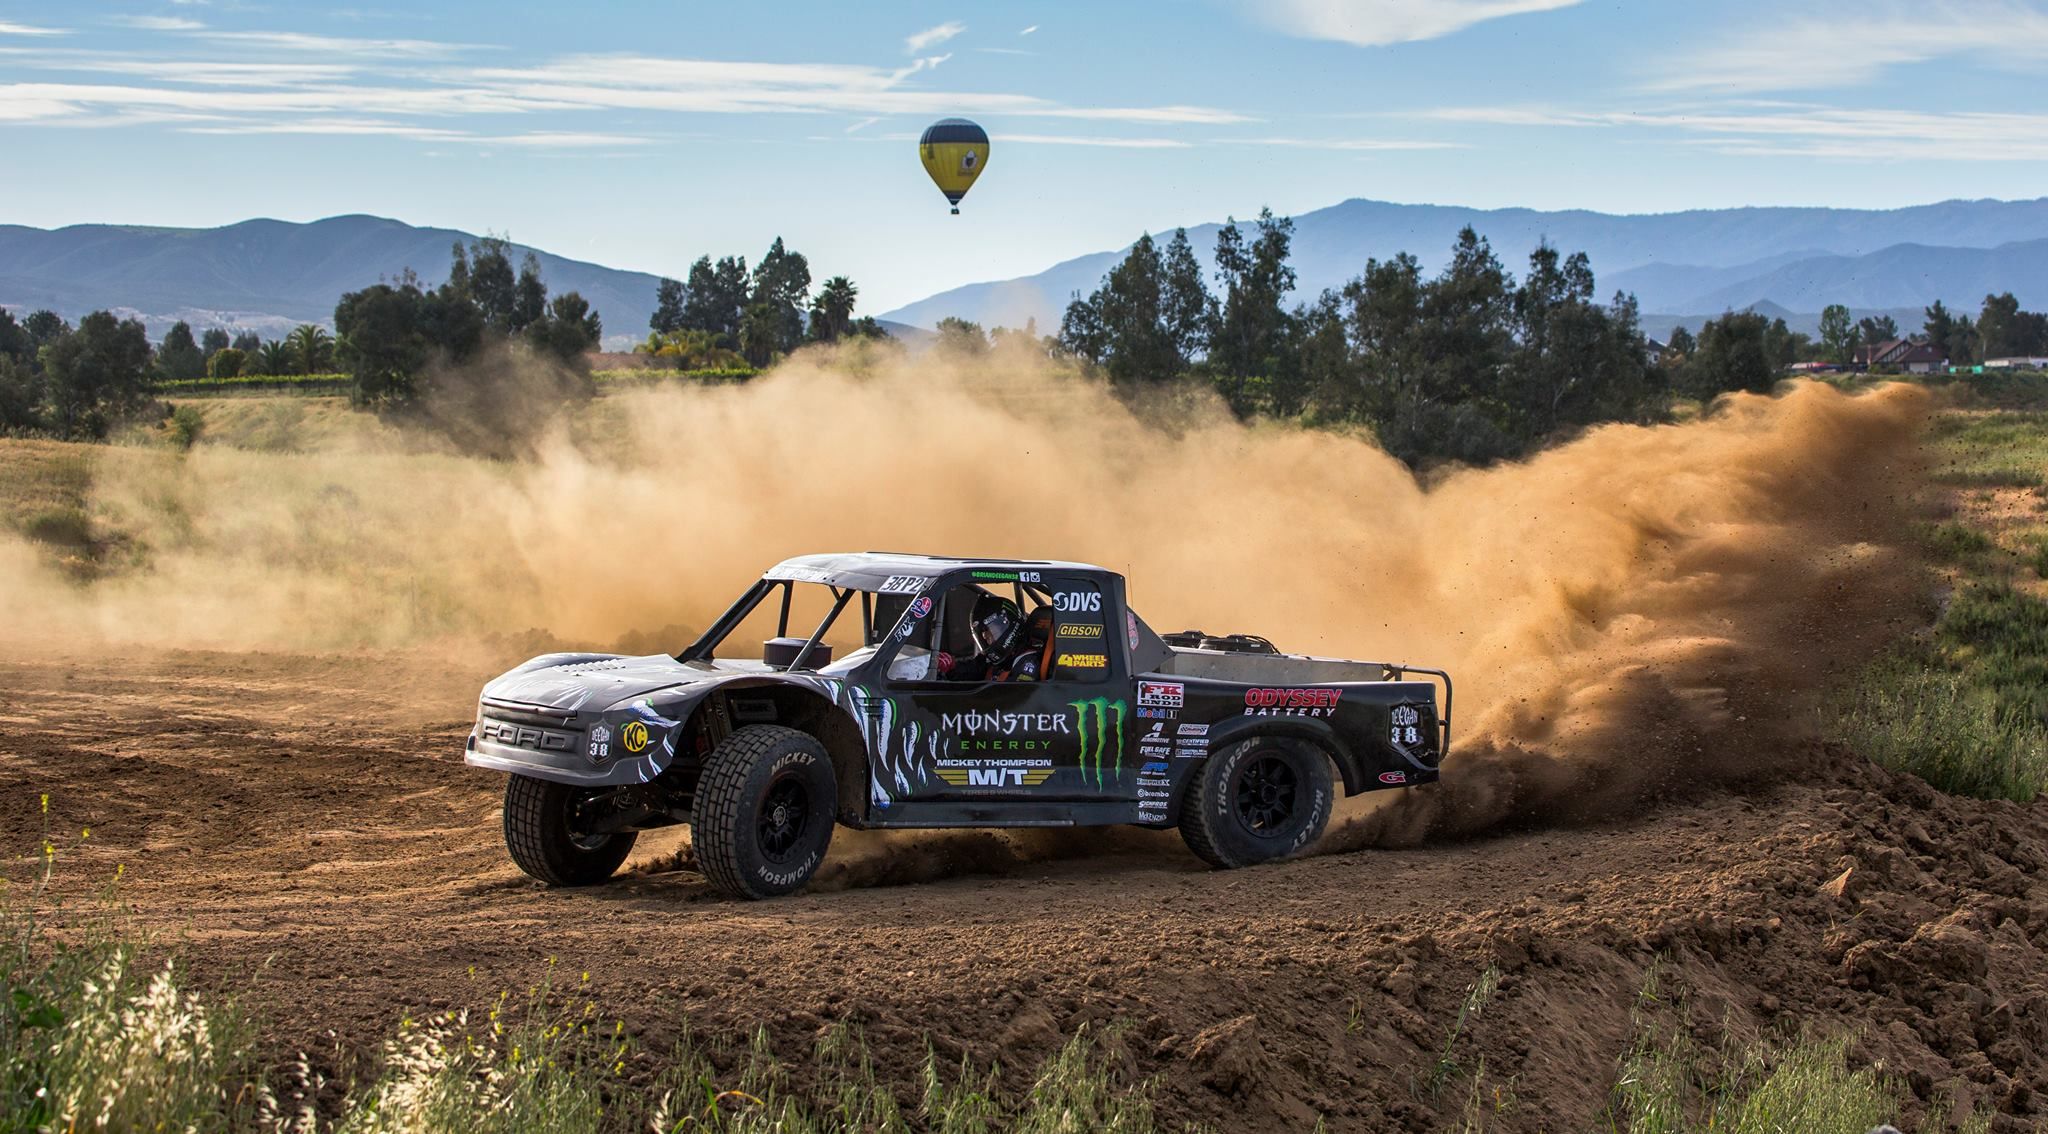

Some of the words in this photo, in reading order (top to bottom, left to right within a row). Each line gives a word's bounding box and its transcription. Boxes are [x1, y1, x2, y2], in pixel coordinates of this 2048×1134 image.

[911, 598, 926, 615] VP
[1068, 592, 1101, 612] DVS
[894, 616, 915, 642] FOX
[1060, 624, 1101, 637] GIBSON
[1072, 660, 1105, 668] PARTS
[1244, 688, 1342, 707] ODYSSEY
[1137, 708, 1165, 719] Mobil
[1244, 708, 1336, 717] BATTERY
[1391, 706, 1418, 726] DEEGAN
[942, 709, 1070, 736] MONSTER
[482, 722, 578, 751] FORD
[626, 724, 646, 749] KC
[1391, 726, 1417, 744] 38
[589, 742, 608, 757] 38
[961, 741, 1050, 750] ENERGY
[771, 752, 816, 776] MICKEY
[937, 759, 981, 767] MICKEY
[982, 759, 1052, 767] THOMPSON
[968, 768, 1029, 787] M/T
[1217, 736, 1261, 817] THOMPSON
[1292, 789, 1324, 851] MICKEY
[757, 850, 818, 885] THOMPSON
